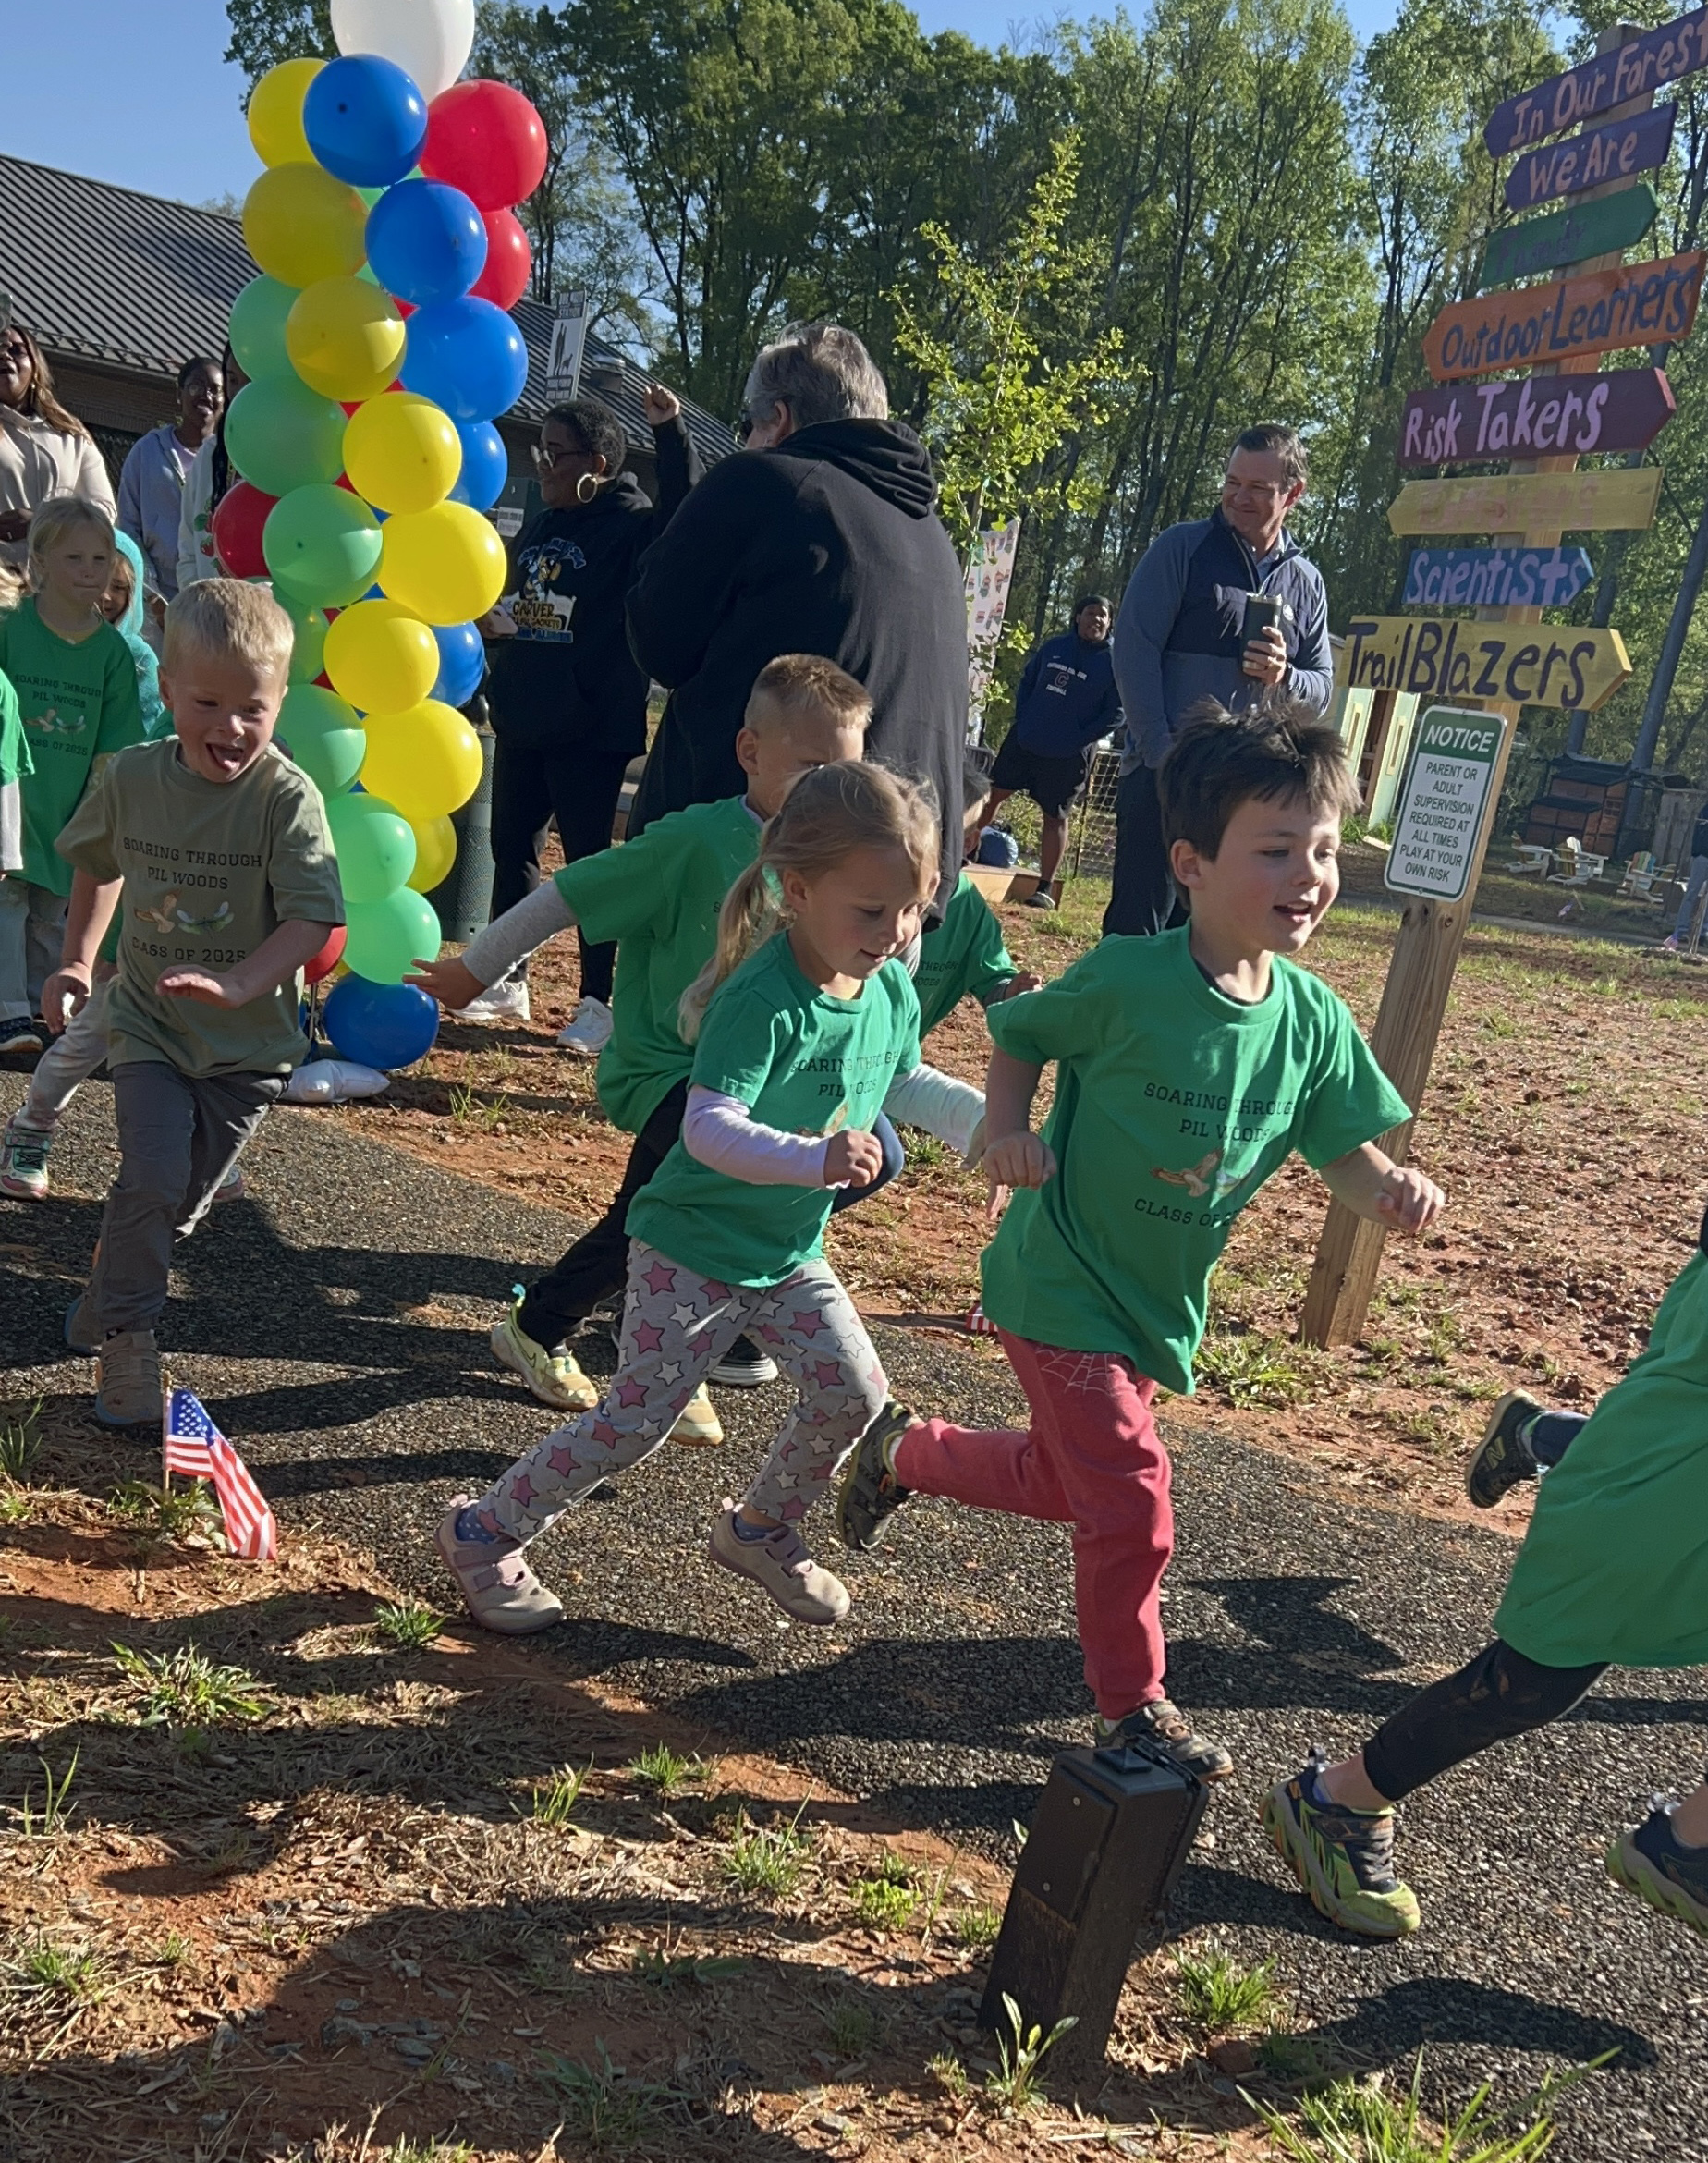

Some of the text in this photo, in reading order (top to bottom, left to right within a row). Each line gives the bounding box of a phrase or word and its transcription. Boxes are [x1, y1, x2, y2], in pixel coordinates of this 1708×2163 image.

[1508, 8, 1708, 147] In Our Forest
[1529, 132, 1637, 201] We Are
[1404, 377, 1609, 462] Risk Takers
[1406, 547, 1585, 605] Scientists
[32, 691, 49, 701] PIL
[1424, 725, 1494, 753] NOTICE
[1425, 761, 1478, 780] PARENT OR
[1432, 780, 1463, 796] ADULT
[1414, 794, 1474, 815] SUPERVISION
[1409, 811, 1470, 832] REQUIRED AT
[1412, 830, 1458, 849] ALL TIMES
[123, 837, 262, 867] SOARING THROUGH
[1400, 844, 1463, 867] PLAY AT YOUR
[147, 866, 228, 889] PIL WOODS
[1405, 862, 1450, 882] OWN RISK
[132, 936, 246, 963] CASS OF 2025
[818, 1084, 845, 1097] PIL
[1144, 1082, 1294, 1115] SOARING THROUG
[1179, 1118, 1209, 1137] PIL
[1134, 1198, 1193, 1224] CLASS
[1199, 1213, 1220, 1228] OF
